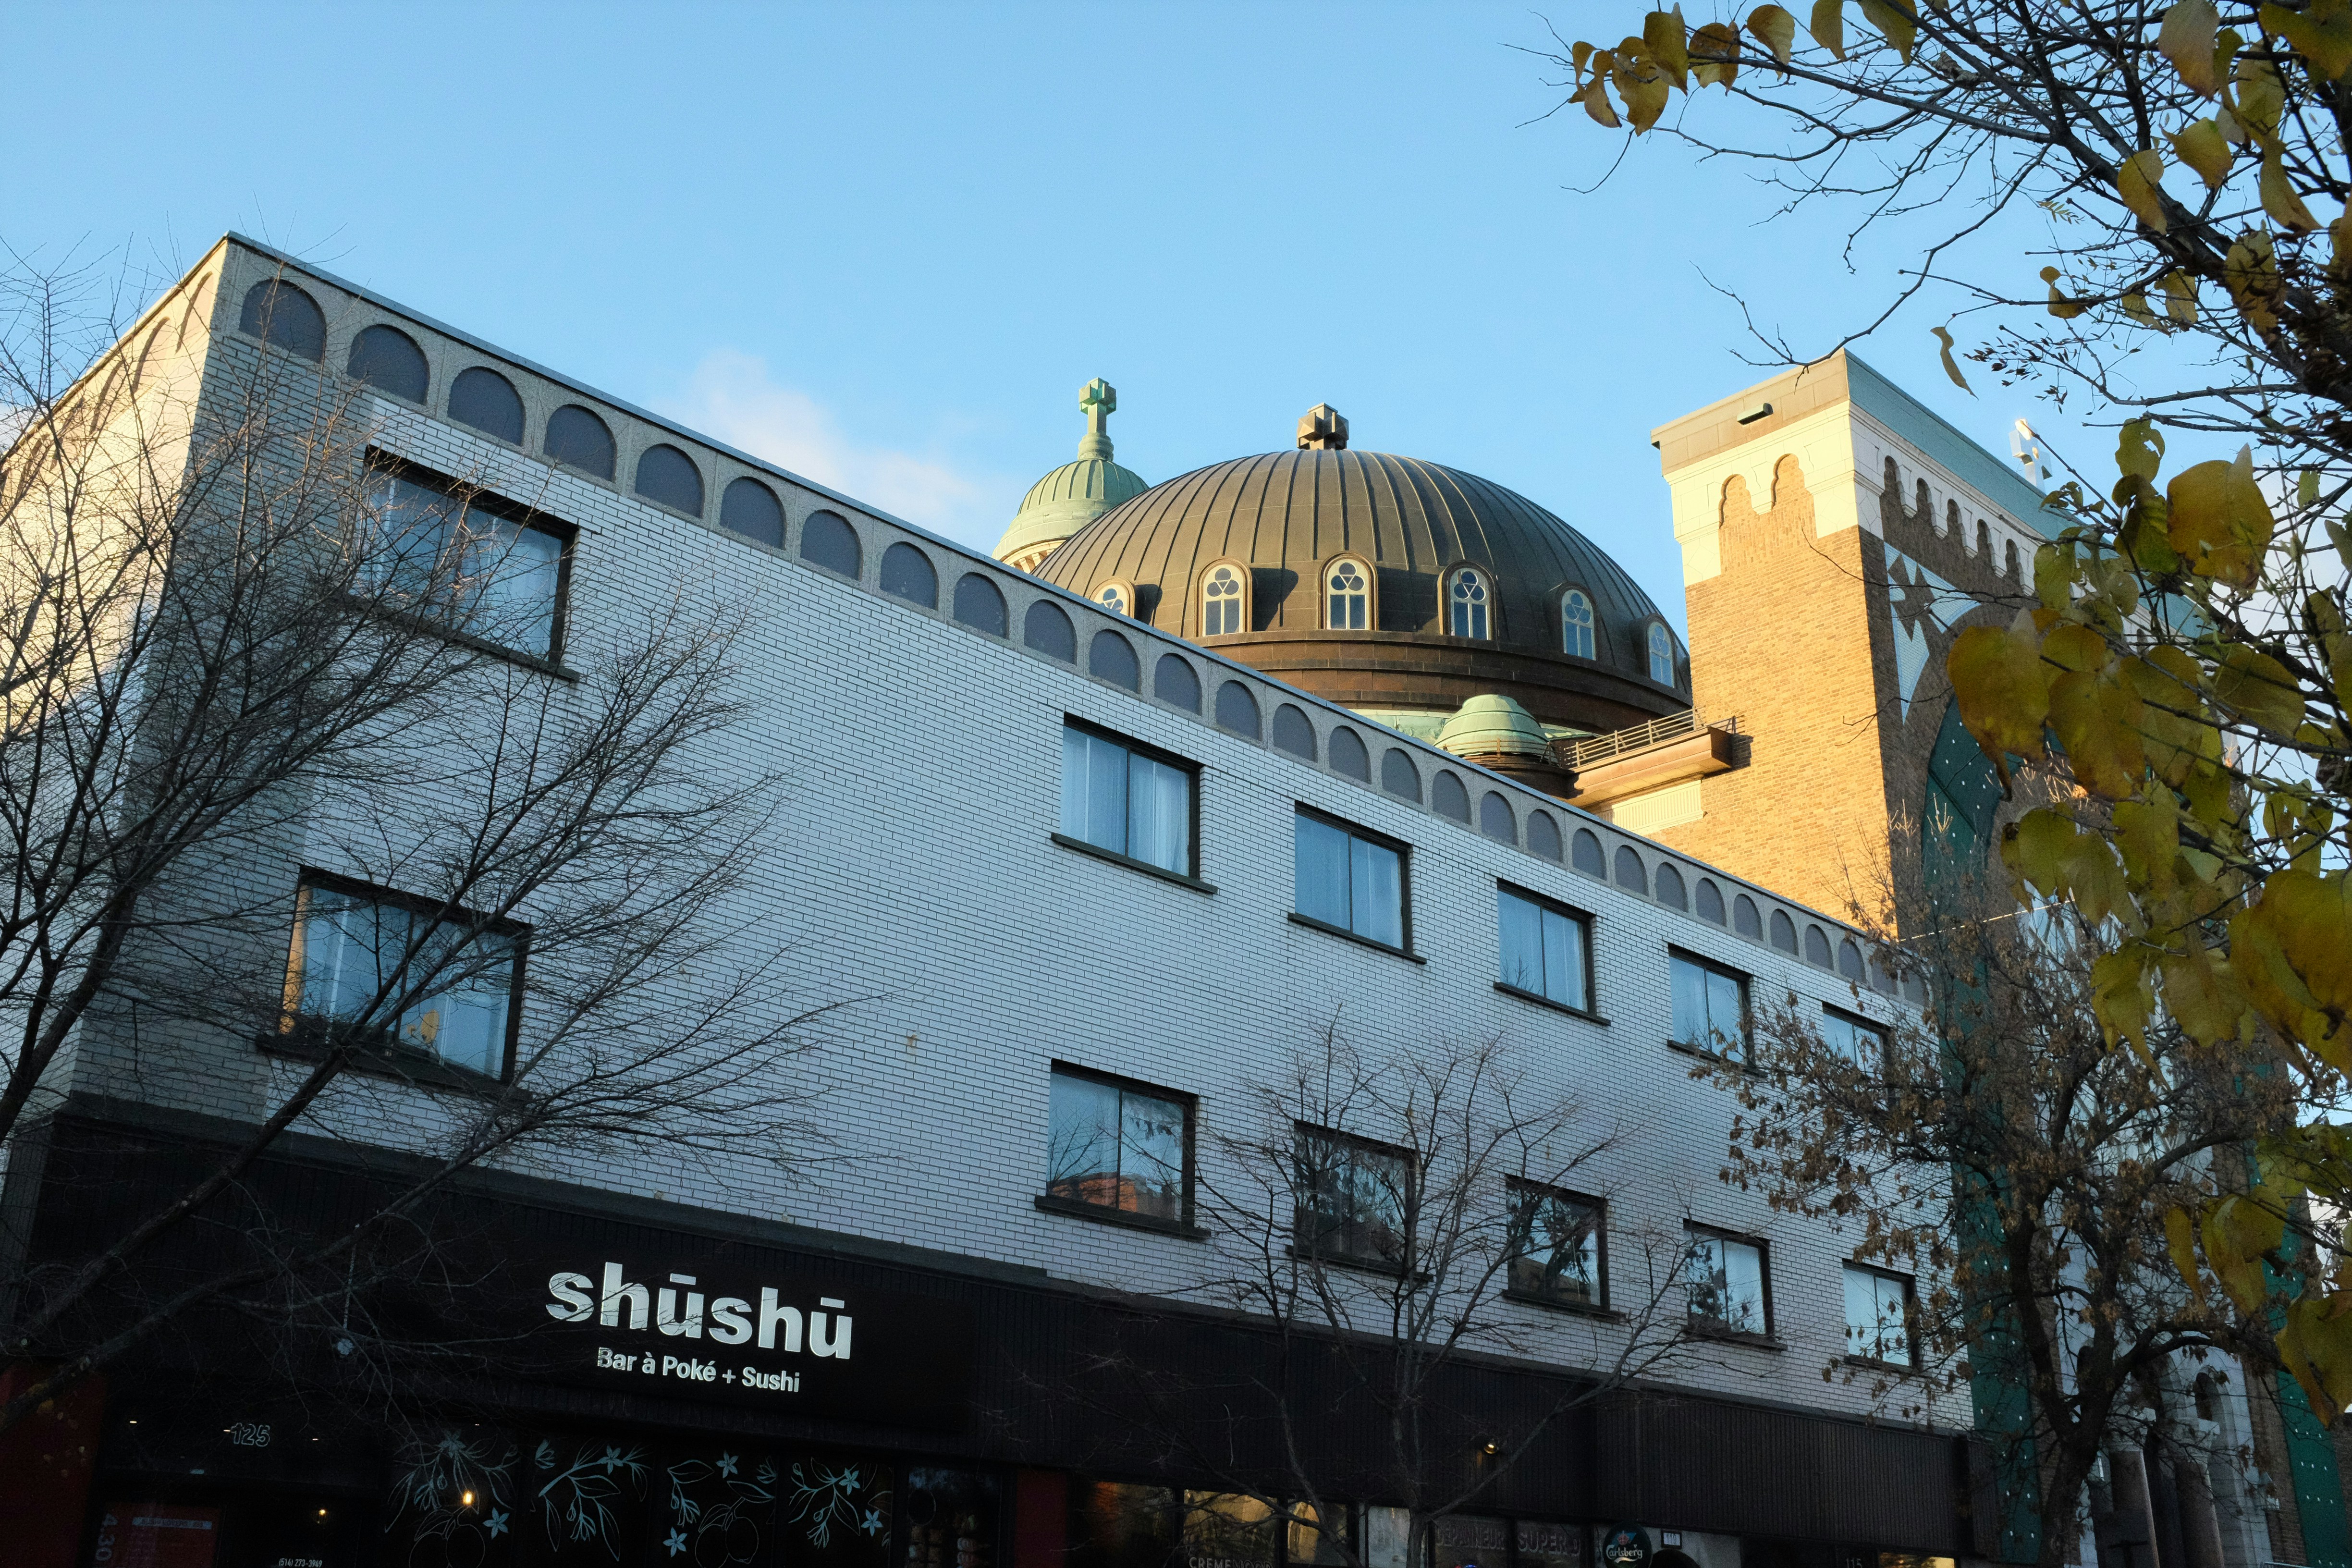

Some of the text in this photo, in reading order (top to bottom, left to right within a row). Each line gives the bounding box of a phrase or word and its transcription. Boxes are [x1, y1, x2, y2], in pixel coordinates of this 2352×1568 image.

[546, 1262, 852, 1360] shūshū
[597, 1347, 800, 1392] Bar à Poké + Sushi
[231, 1422, 271, 1447] 125
[1517, 1530, 1568, 1555] SUPER
[1605, 1544, 1643, 1560] Carlsberg
[279, 1558, 294, 1567] (514)
